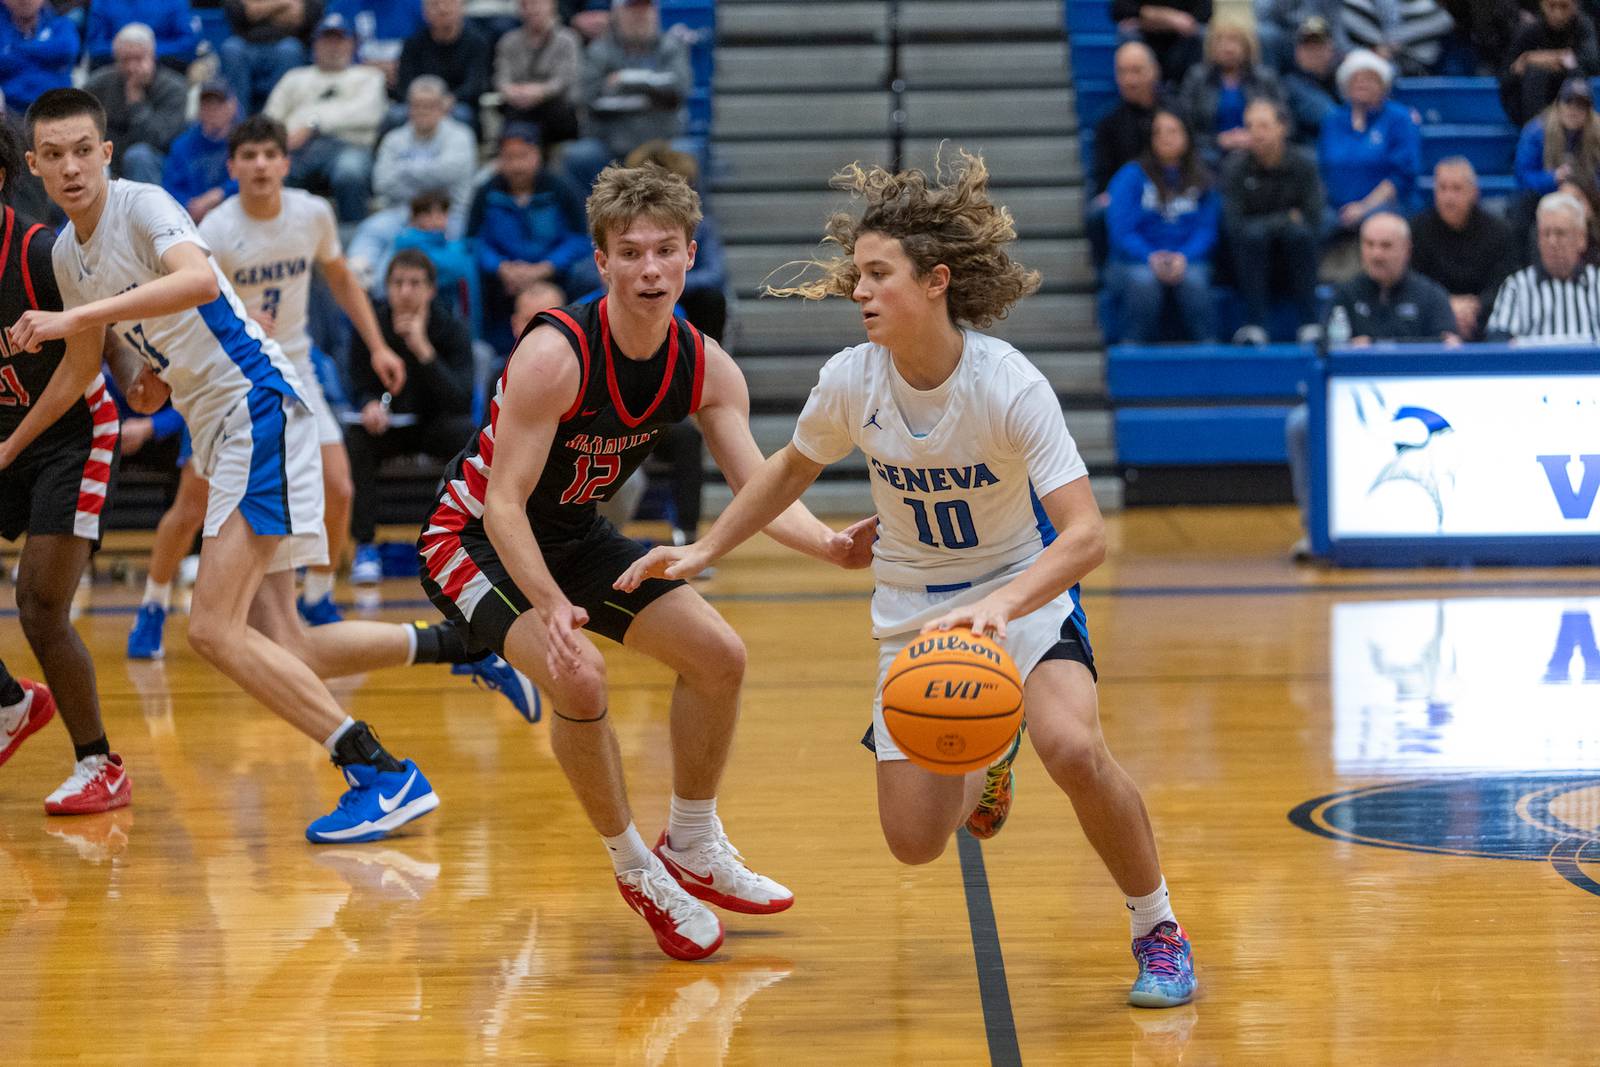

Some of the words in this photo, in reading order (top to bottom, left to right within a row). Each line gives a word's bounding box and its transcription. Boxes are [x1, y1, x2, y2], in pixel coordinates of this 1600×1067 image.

[235, 258, 306, 284] GENEVA
[560, 454, 621, 504] 12
[871, 456, 1001, 493] GENEVA
[903, 497, 979, 549] 10
[909, 635, 1001, 664] Wilson
